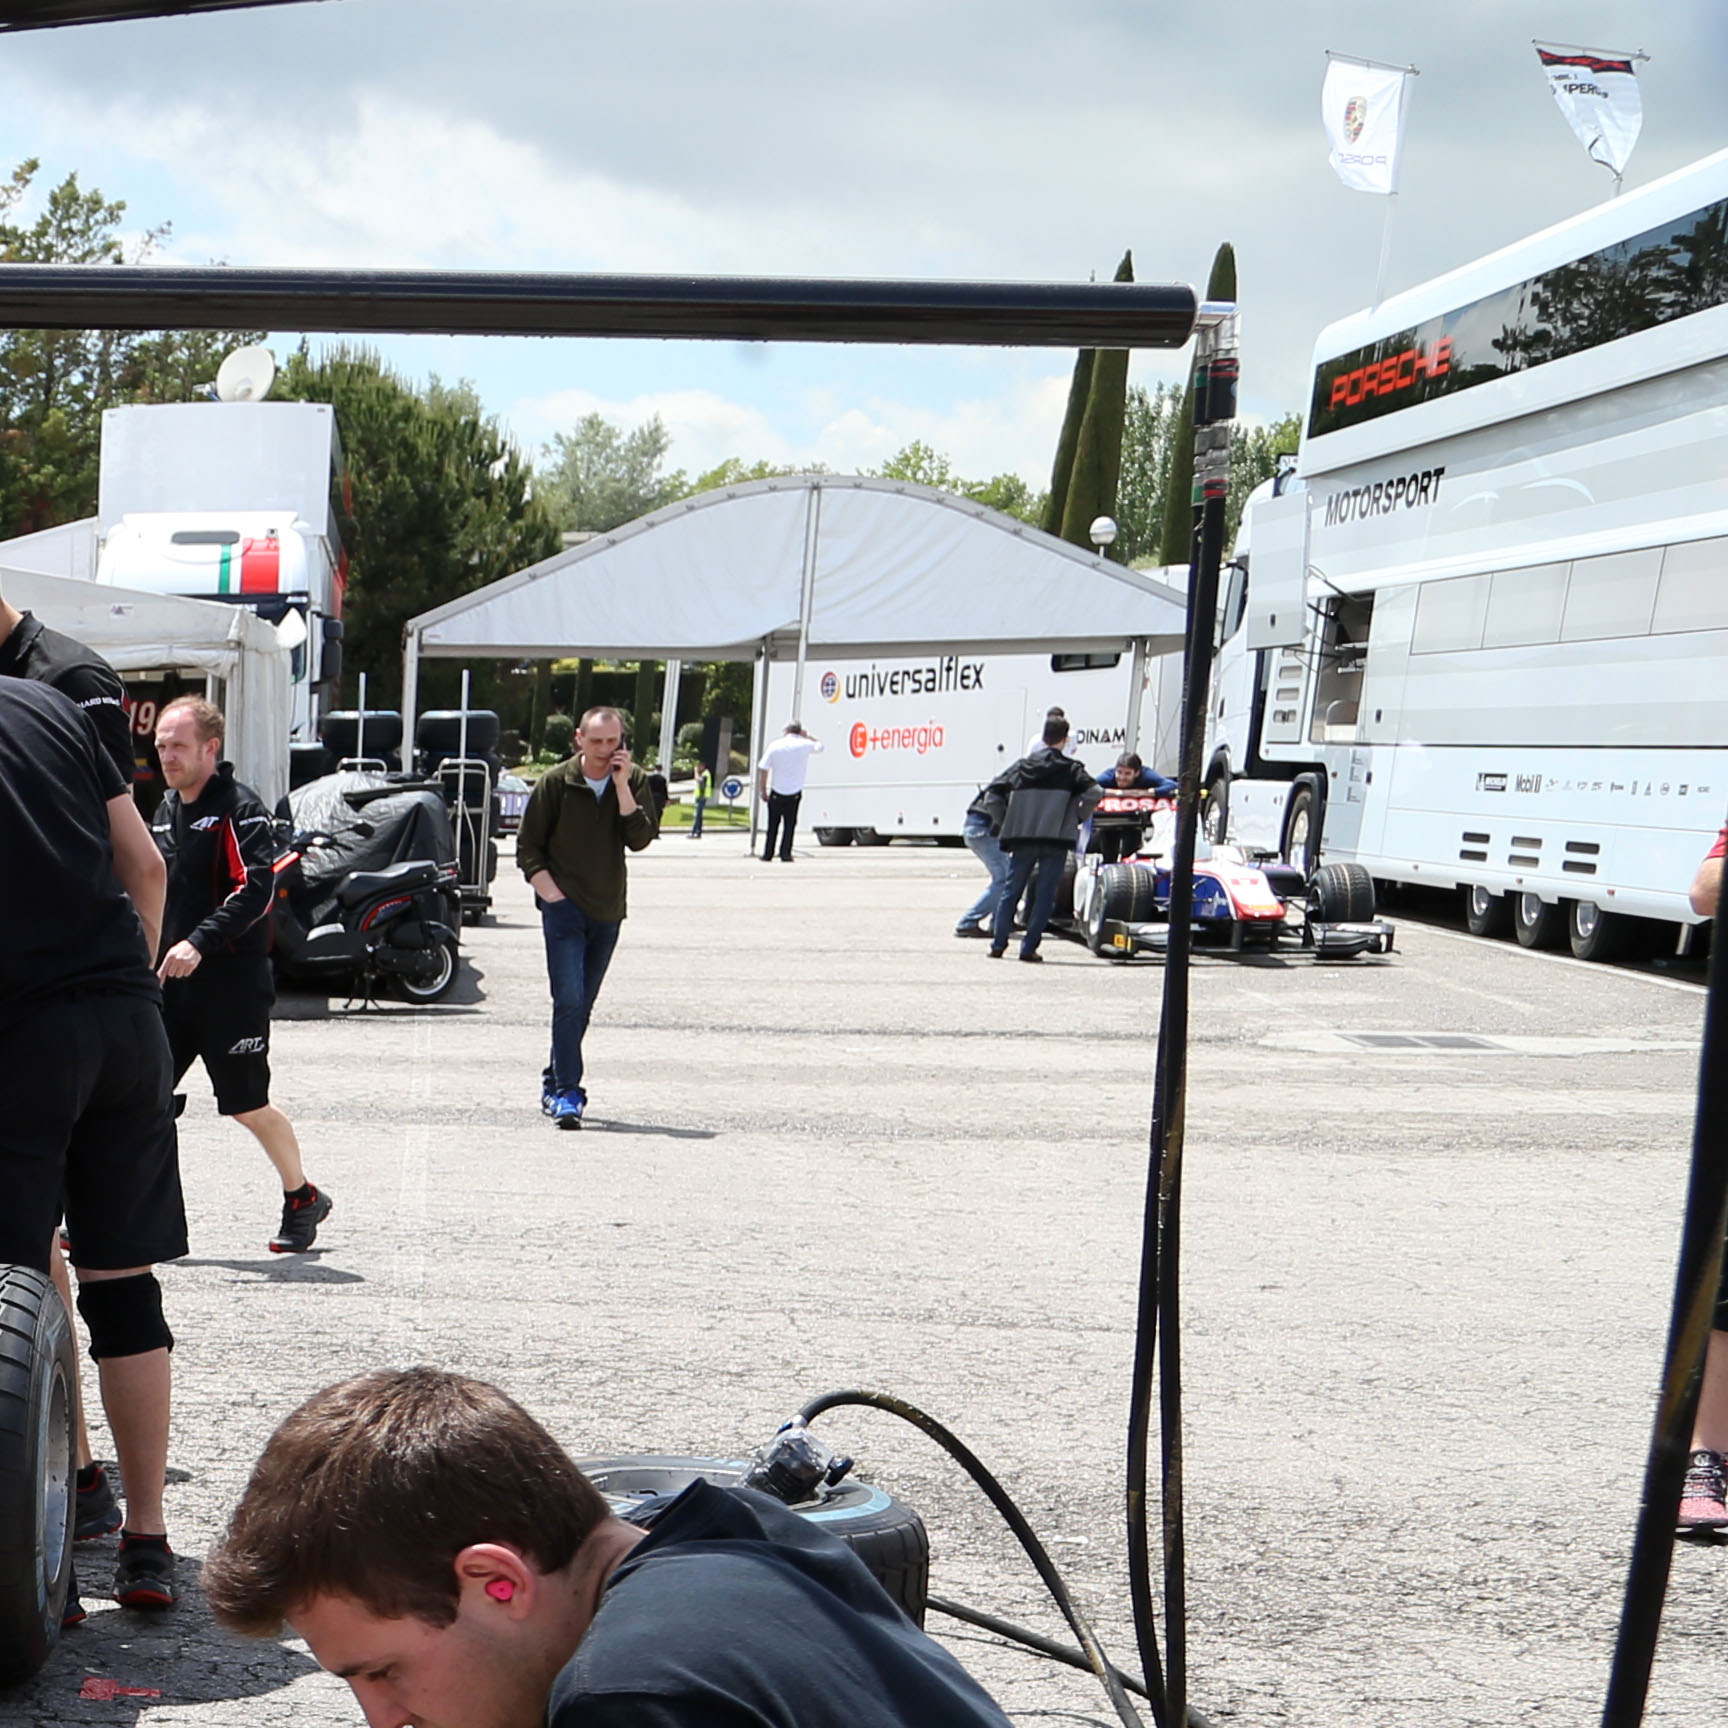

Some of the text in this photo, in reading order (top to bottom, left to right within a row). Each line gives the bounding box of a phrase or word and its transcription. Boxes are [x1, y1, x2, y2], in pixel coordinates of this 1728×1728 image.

[1330, 336, 1454, 411] PORSCHE
[1325, 466, 1446, 528] MOTORSPORT
[845, 657, 985, 700] universalflex
